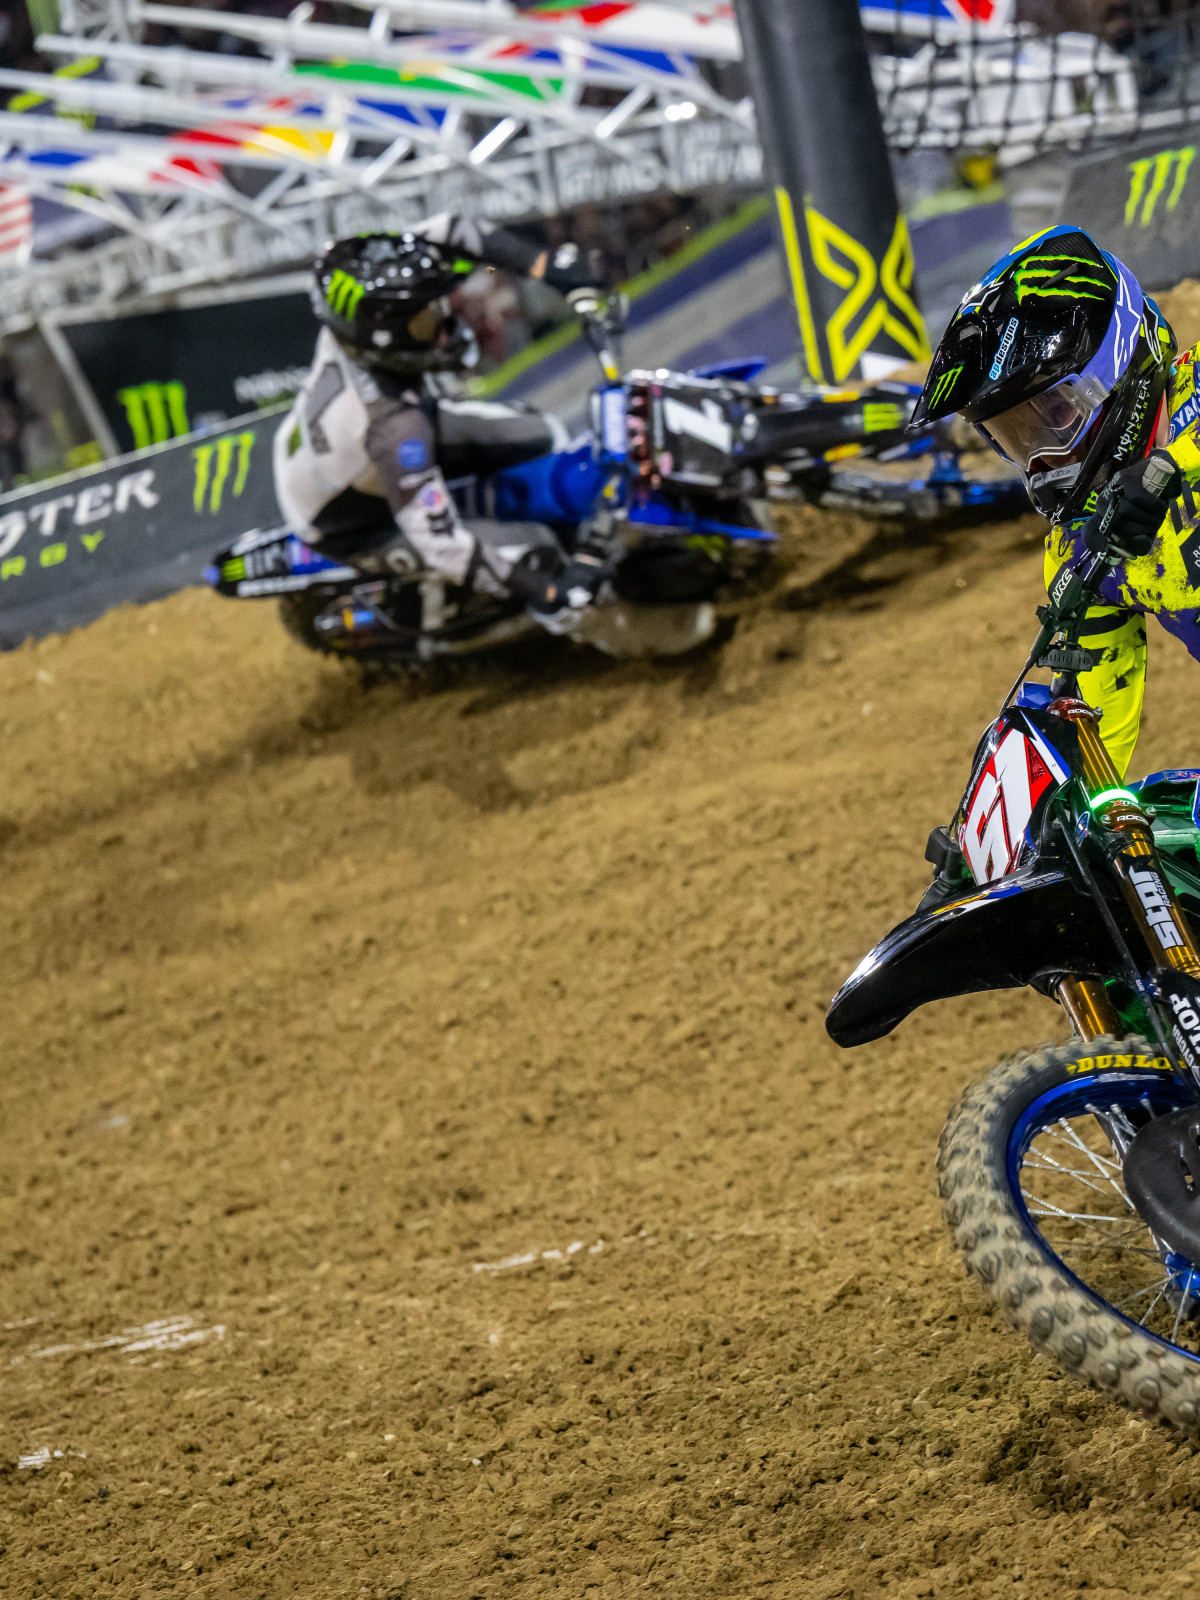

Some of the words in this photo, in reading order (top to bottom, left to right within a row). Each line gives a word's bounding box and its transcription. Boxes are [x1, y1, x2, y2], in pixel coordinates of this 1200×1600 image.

[989, 318, 1019, 380] apdesigns
[1128, 391, 1151, 451] ENERGY
[1052, 568, 1073, 608] ARC
[964, 728, 1033, 887] 61
[1150, 871, 1172, 908] RACING
[1076, 1054, 1187, 1072] DUNLO
[1172, 1023, 1195, 1068] CYCRA
